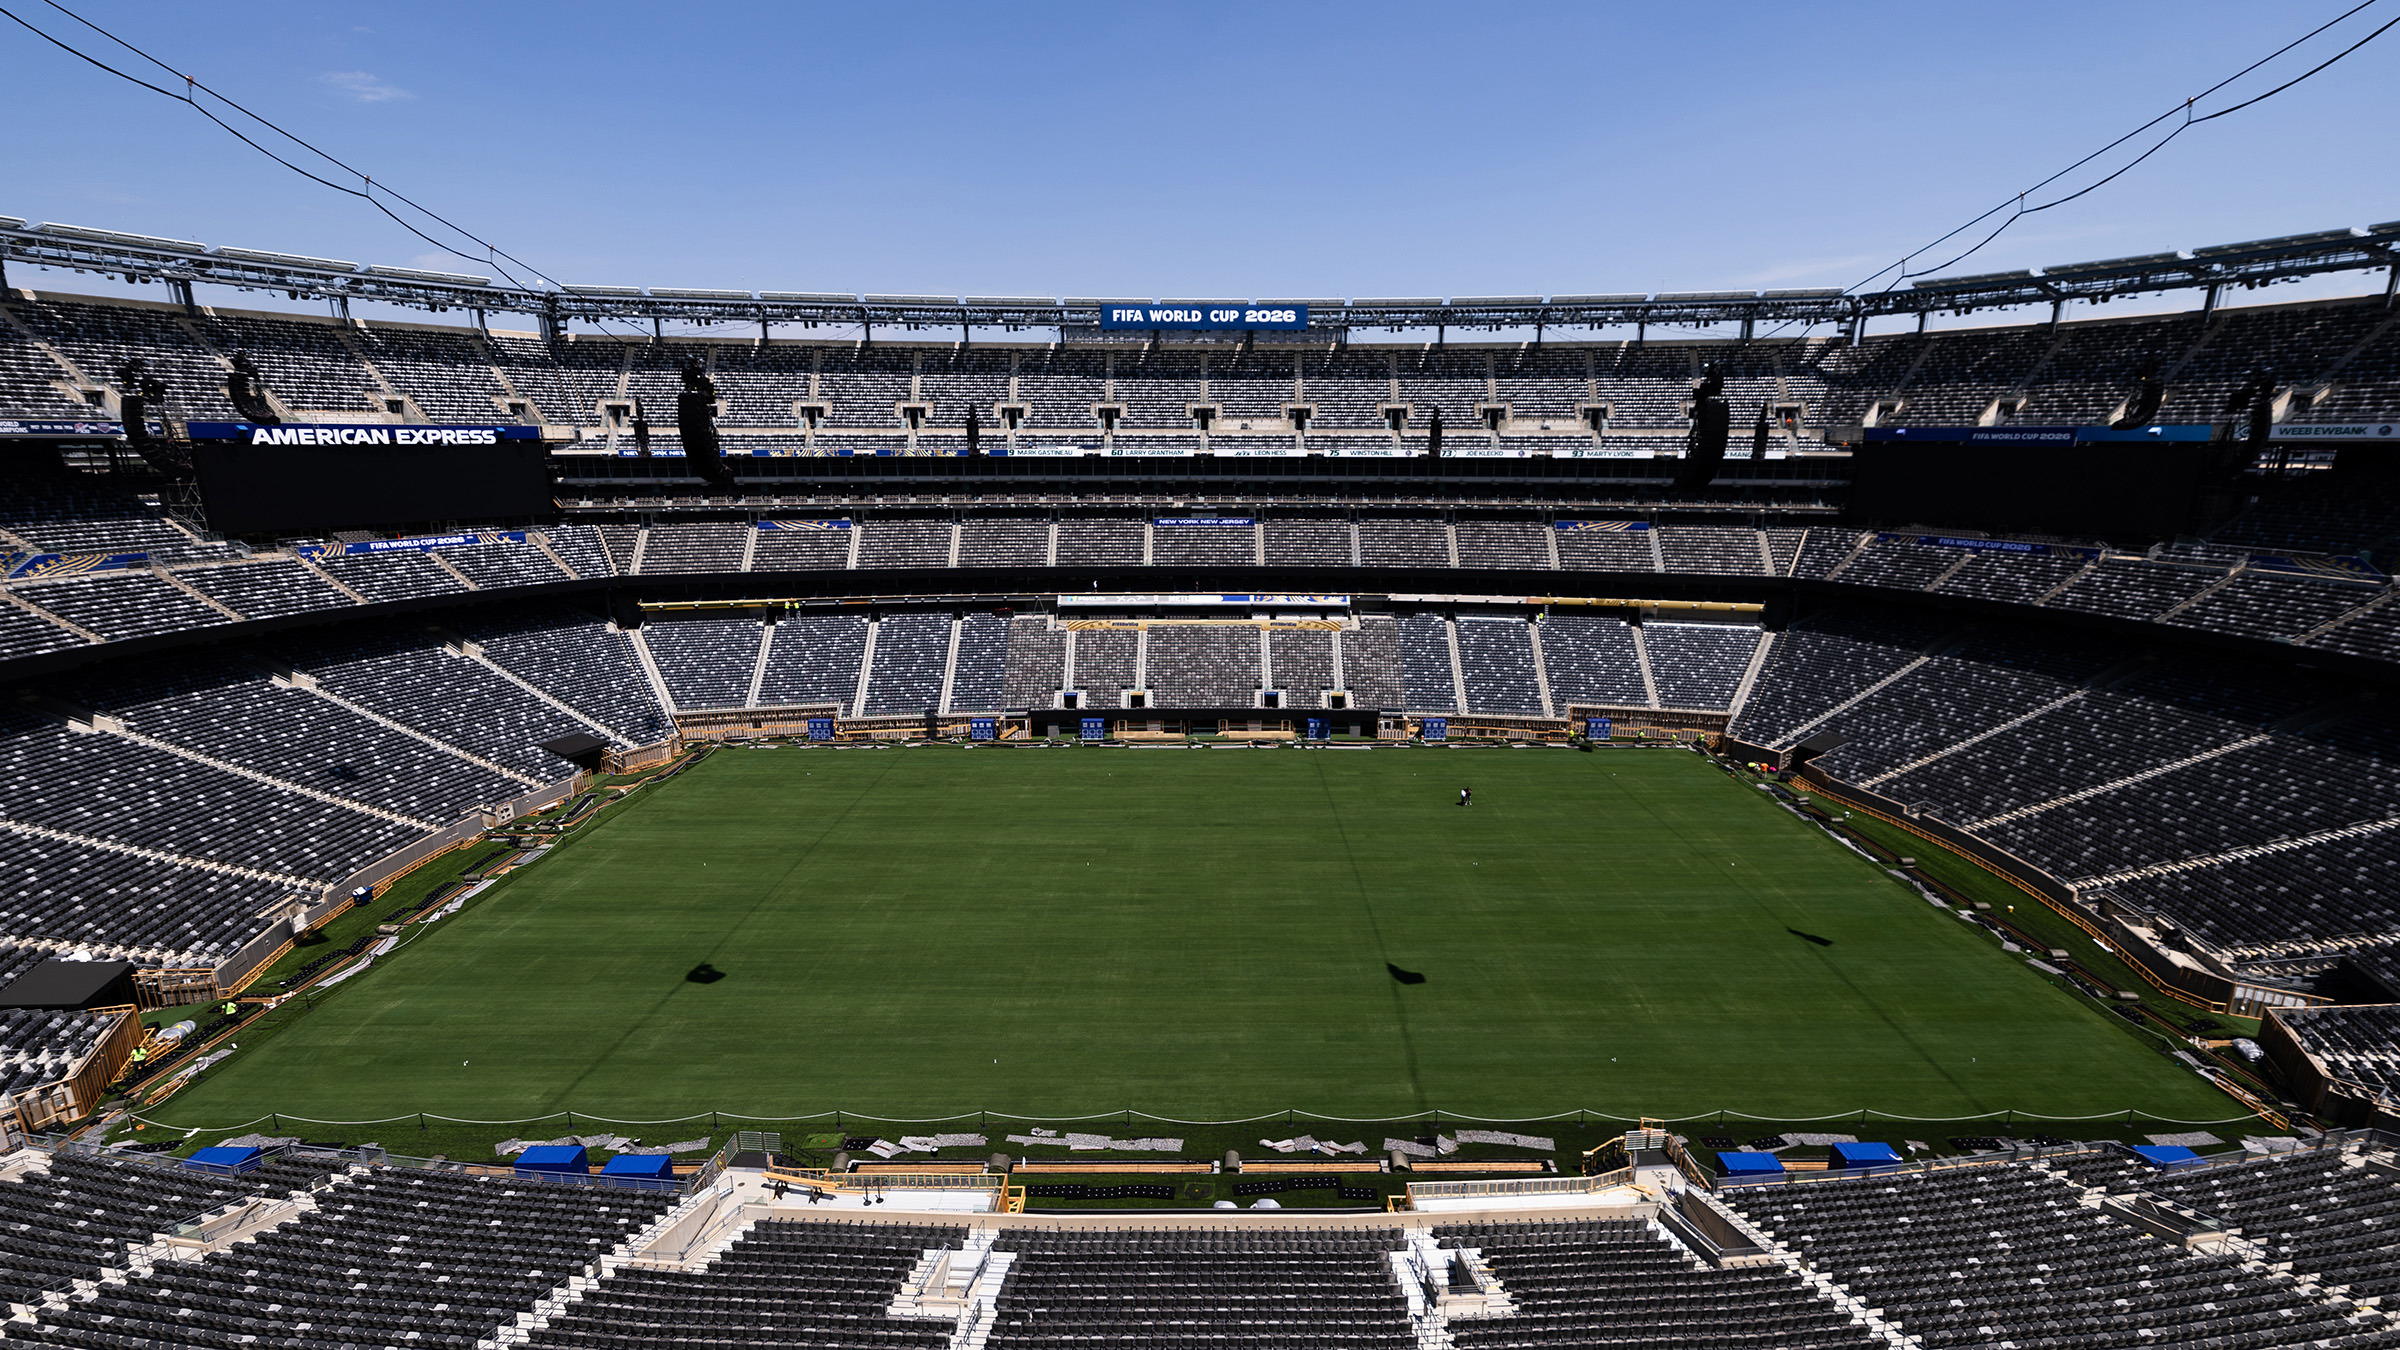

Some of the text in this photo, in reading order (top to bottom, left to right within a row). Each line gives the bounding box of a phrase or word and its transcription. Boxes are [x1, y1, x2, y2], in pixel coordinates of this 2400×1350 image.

[1112, 309, 1296, 323] FIFA WORLD CUP 2026
[252, 428, 497, 445] AMERICAN EXPRESS
[2279, 426, 2368, 435] WEEB EWBANK
[369, 542, 389, 550] FIFA
[389, 539, 420, 548] WORLD
[420, 538, 437, 546] CUP
[437, 536, 465, 544] 2026
[1938, 537, 1955, 545] FIFA
[1956, 539, 1984, 547] WORLD
[2002, 542, 2032, 551] 2026
